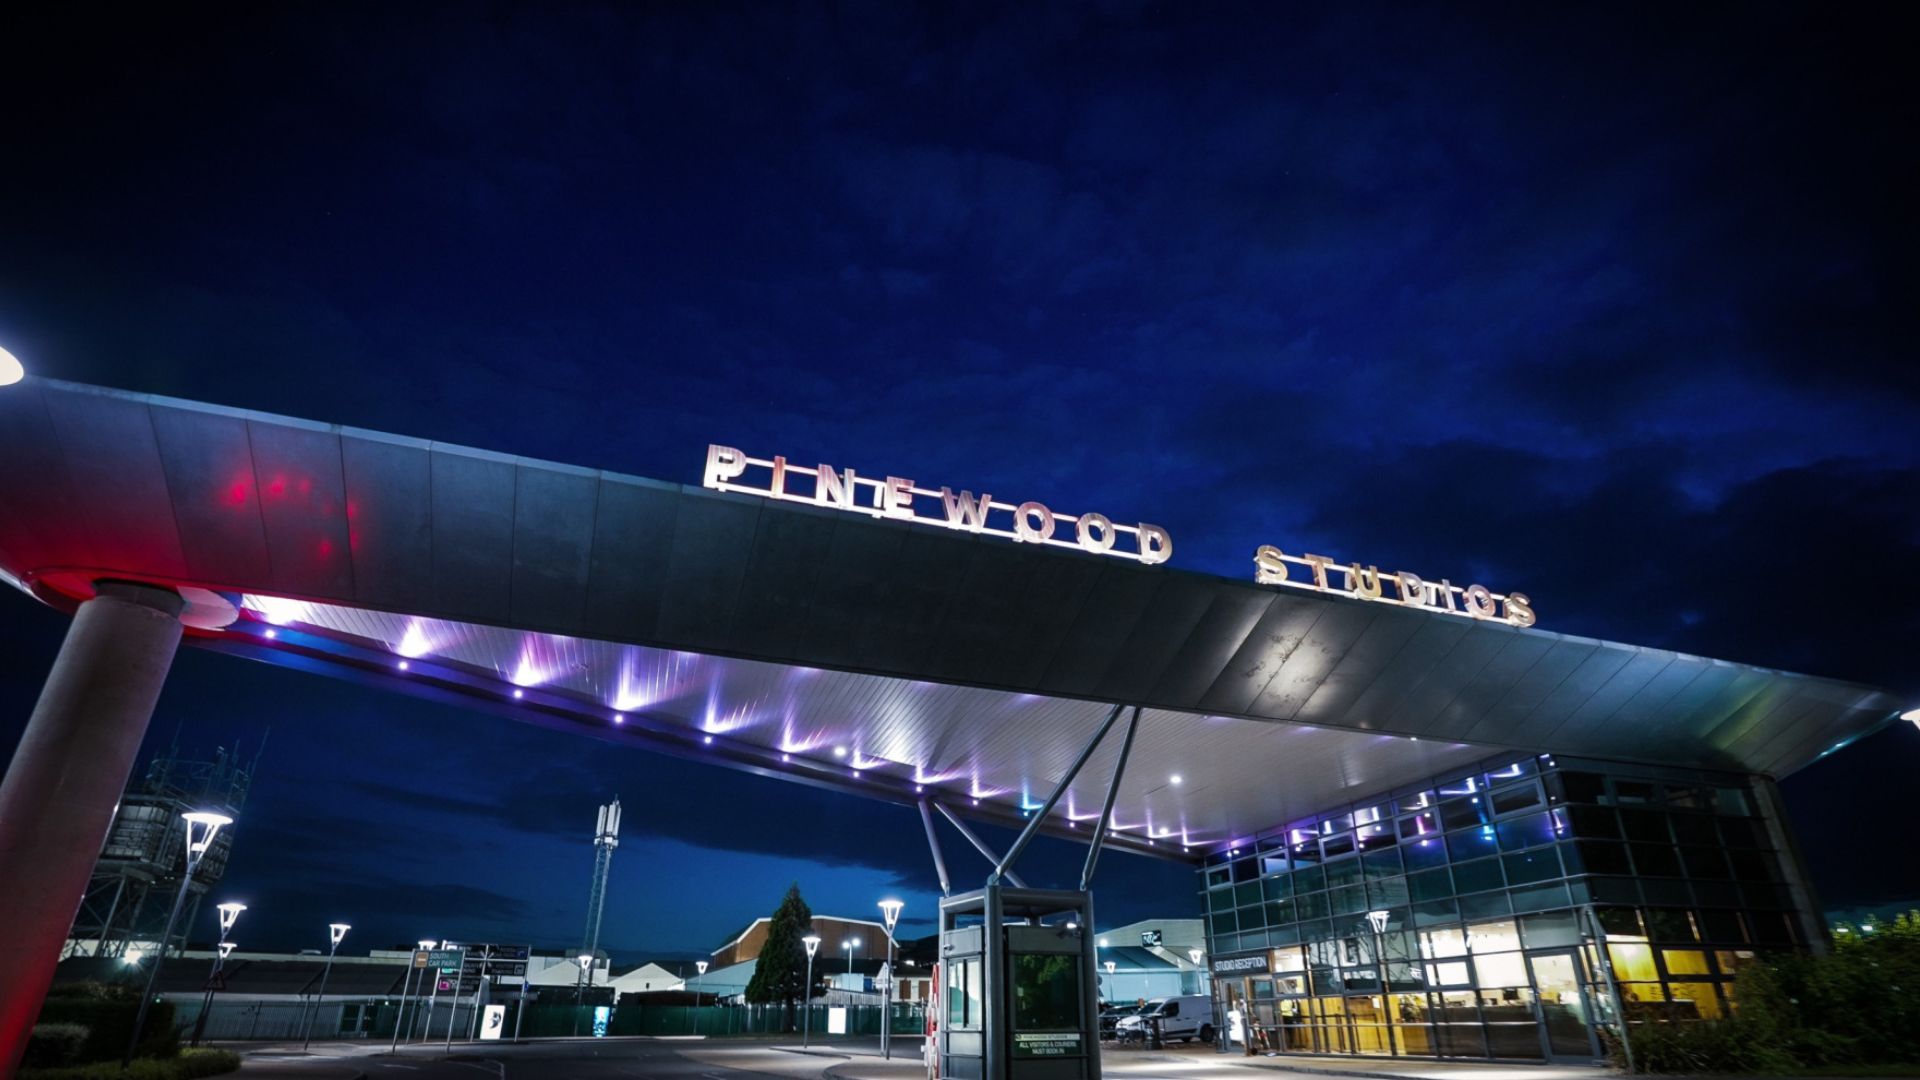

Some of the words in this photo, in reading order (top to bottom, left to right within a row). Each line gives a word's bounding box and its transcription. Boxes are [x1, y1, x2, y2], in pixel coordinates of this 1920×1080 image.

[704, 444, 1173, 564] PINEWOOD
[1254, 544, 1536, 627] STUDIOS
[1214, 959, 1235, 971] STUDIO
[1235, 956, 1267, 969] RECEPTION
